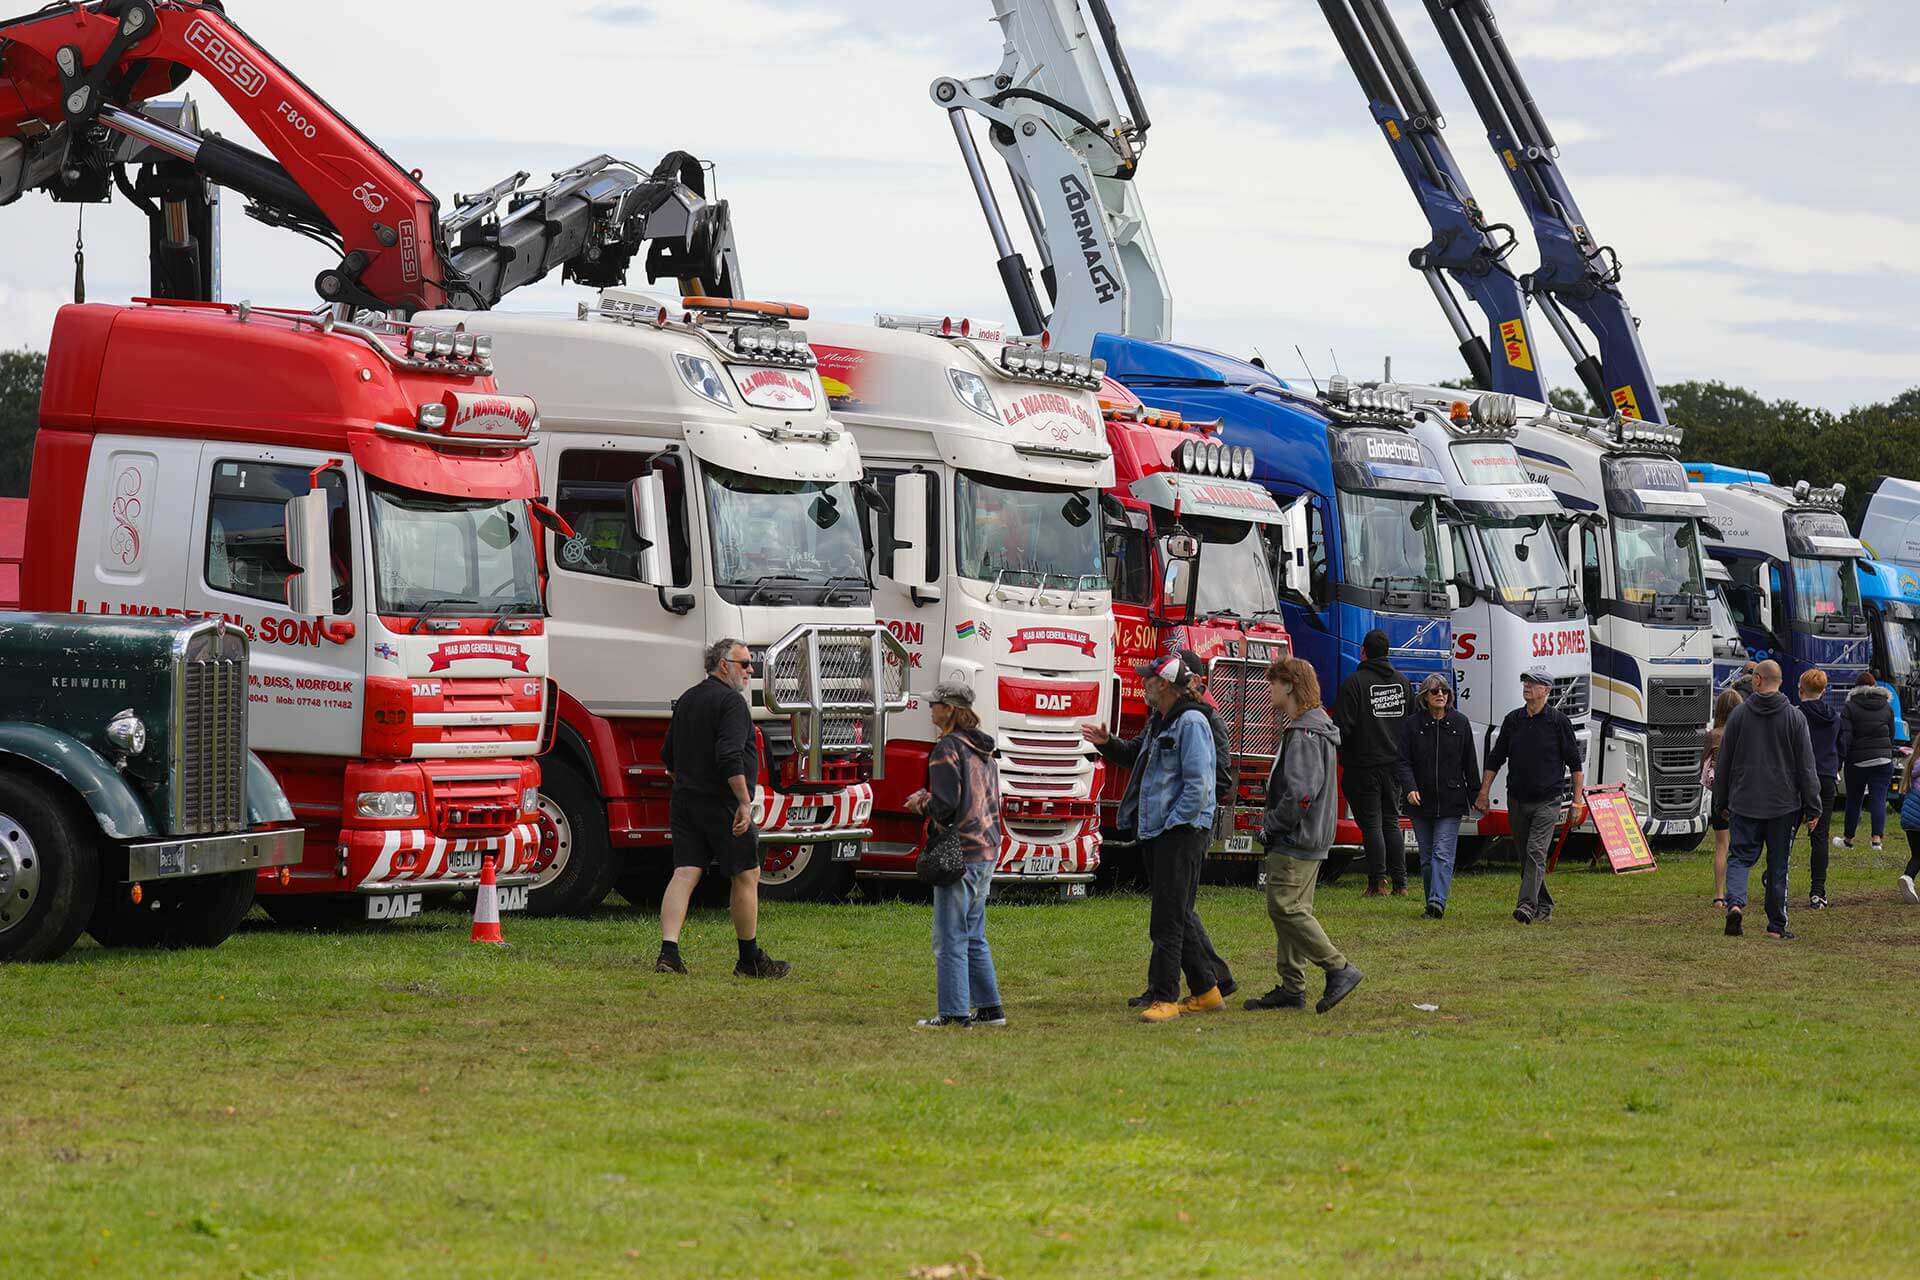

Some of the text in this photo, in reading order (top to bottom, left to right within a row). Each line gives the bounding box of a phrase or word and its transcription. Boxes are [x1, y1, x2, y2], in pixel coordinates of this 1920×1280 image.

[190, 25, 261, 92] FASSI
[277, 101, 316, 138] F800
[402, 225, 416, 277] FASSI
[1060, 173, 1121, 304] CORMACH
[1502, 323, 1523, 363] HYVA
[473, 399, 512, 419] WARREN
[514, 406, 531, 433] SON
[1020, 392, 1073, 416] WARREN
[1076, 404, 1097, 436] SON
[259, 616, 321, 648] SON
[876, 619, 924, 645] ON
[1046, 630, 1067, 640] GENERAL
[1135, 624, 1157, 650] SON
[1557, 630, 1586, 655] SPARES
[459, 644, 470, 654] AND
[471, 643, 494, 653] GENERAL
[495, 644, 518, 656] HAULAGE
[52, 677, 126, 689] KENWORTH
[263, 675, 294, 691] DISS,
[296, 678, 353, 693] NORFOLK
[411, 683, 441, 696] DAF
[1035, 694, 1072, 710] DAF
[368, 893, 422, 920] DAF
[498, 886, 529, 911] DAF
